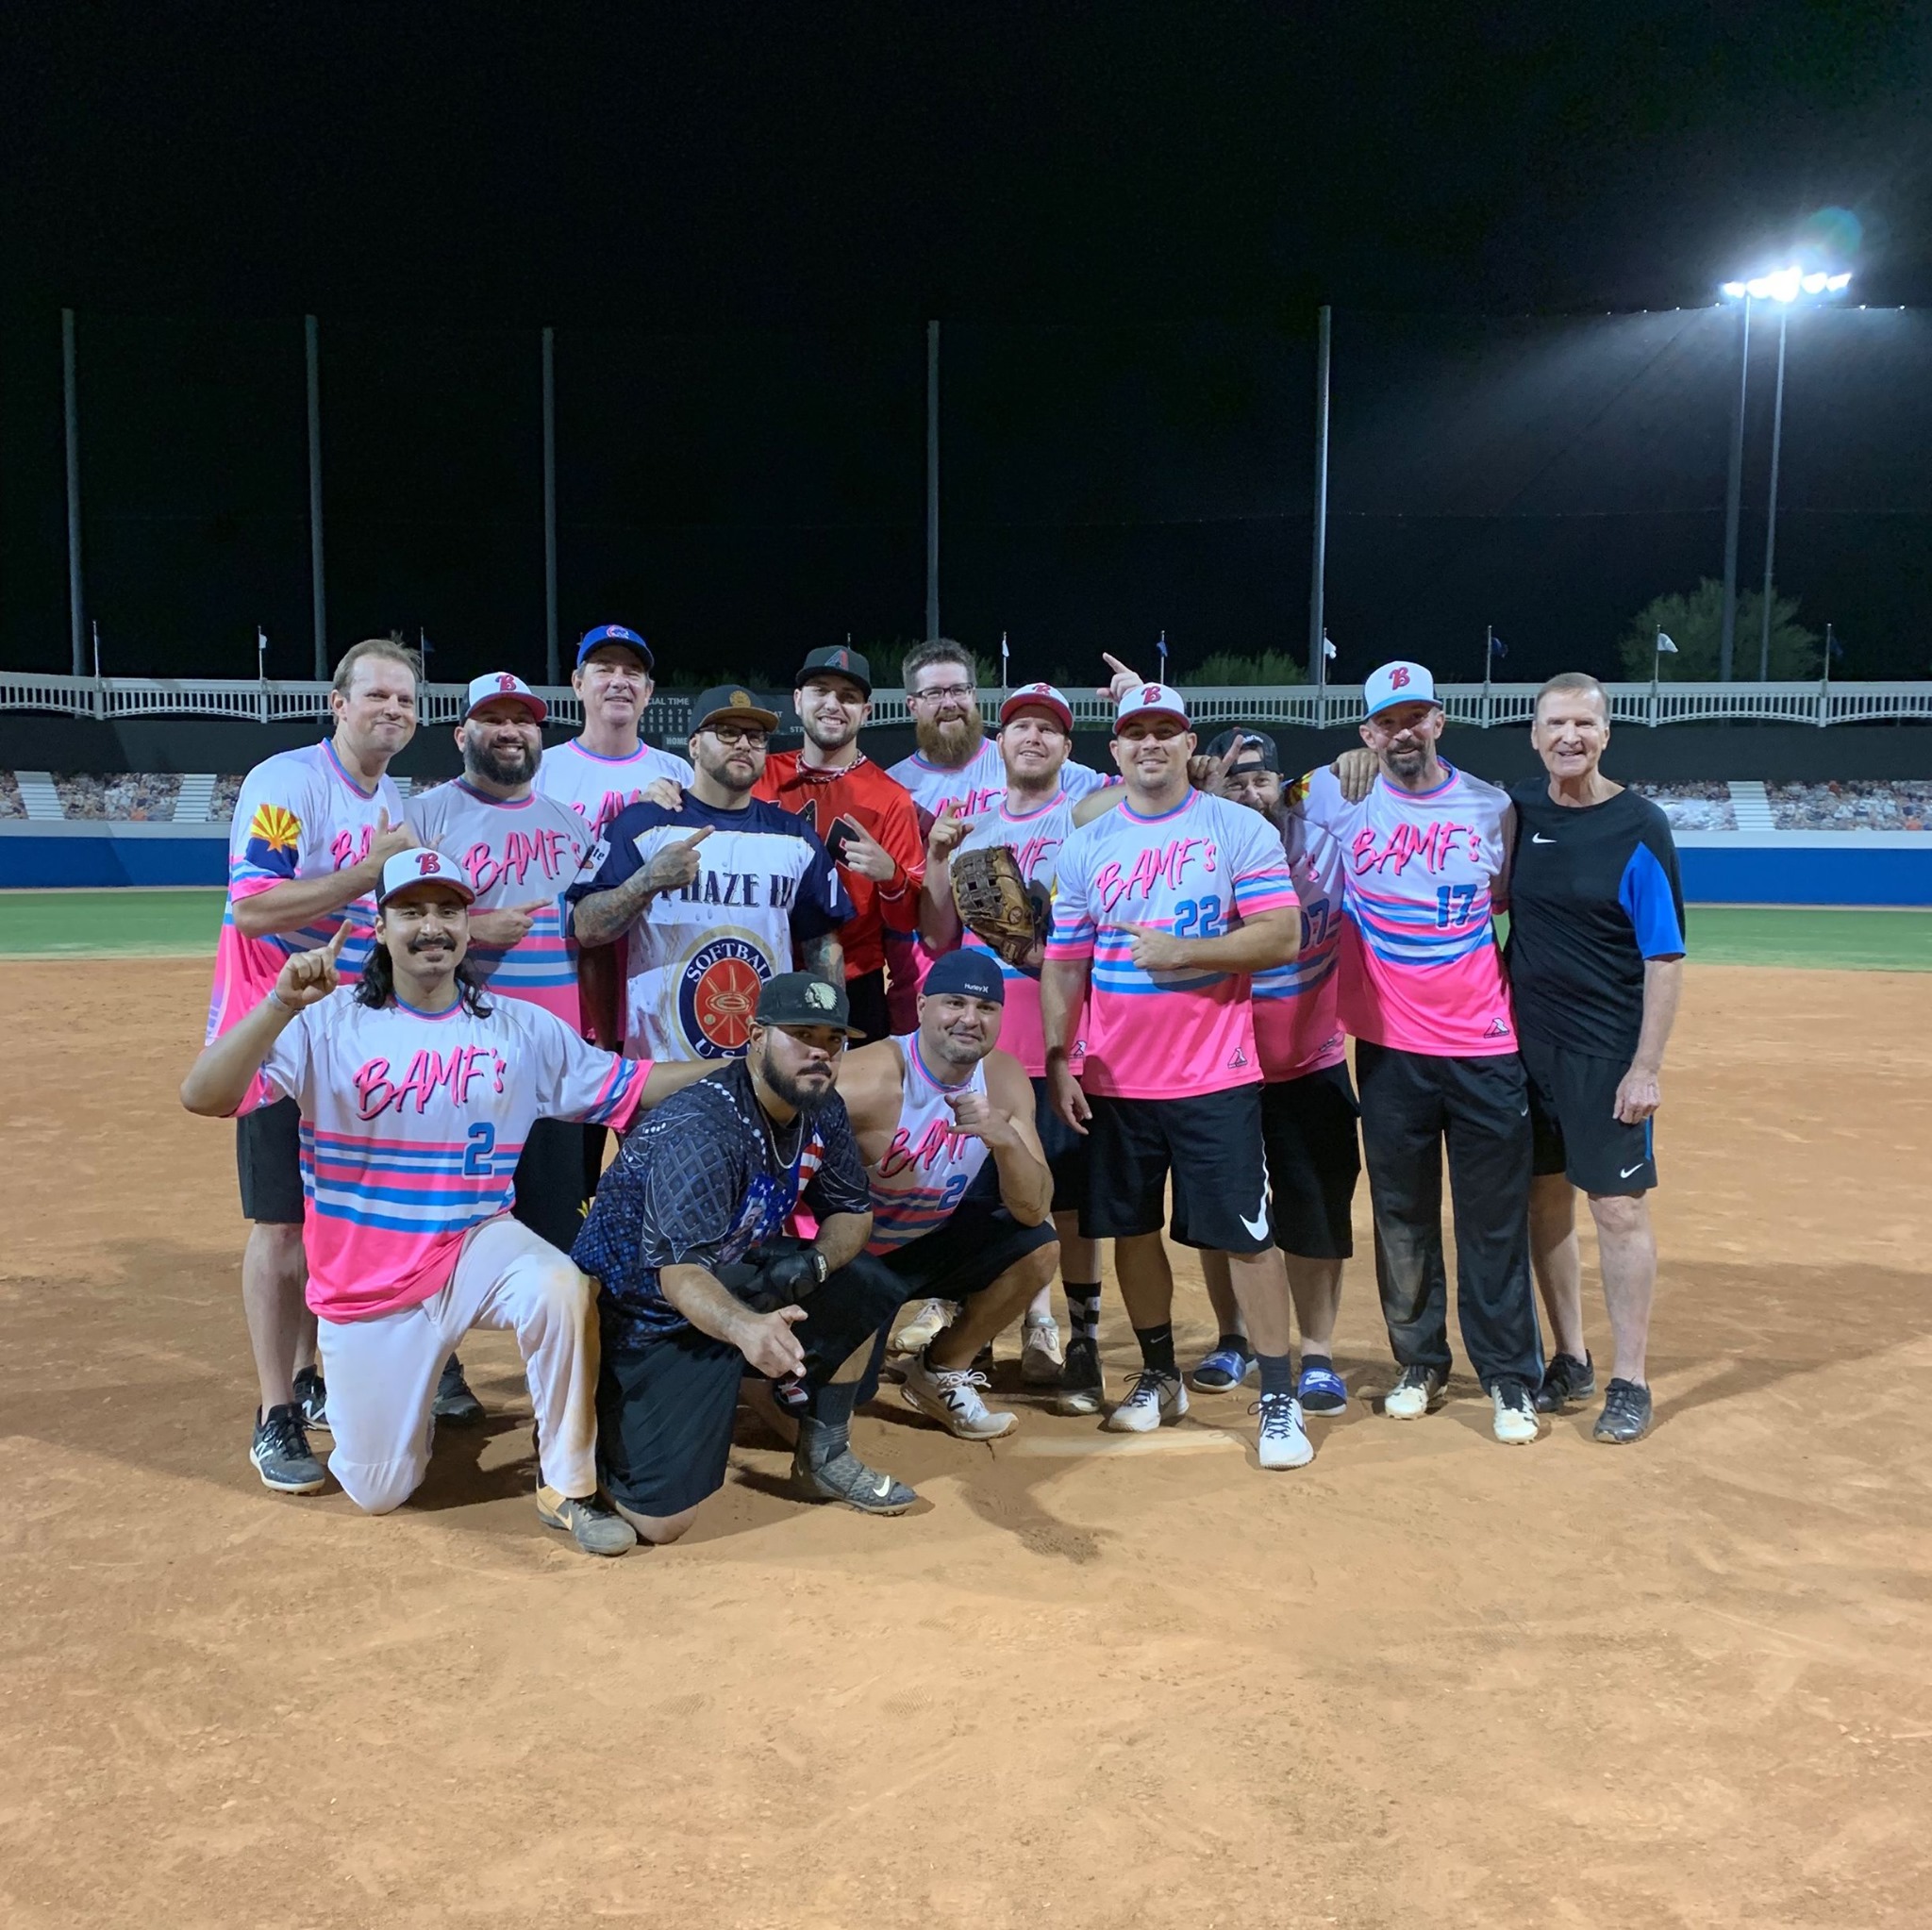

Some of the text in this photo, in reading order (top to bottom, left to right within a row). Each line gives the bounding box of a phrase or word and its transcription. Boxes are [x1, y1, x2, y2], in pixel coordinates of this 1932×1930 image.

[495, 674, 517, 692] B
[1141, 686, 1161, 706] B
[1389, 666, 1410, 690] B
[667, 697, 690, 706] TIME
[666, 737, 688, 745] HOME
[415, 852, 441, 875] B
[1352, 821, 1481, 876] BAMF's
[660, 870, 760, 907] HAZE
[1096, 837, 1216, 913] BAMF's
[1174, 894, 1221, 939] 22
[1436, 883, 1478, 929] 17
[352, 1044, 508, 1122] BAMF's
[463, 1121, 496, 1178] 2
[935, 1173, 969, 1212] 2
